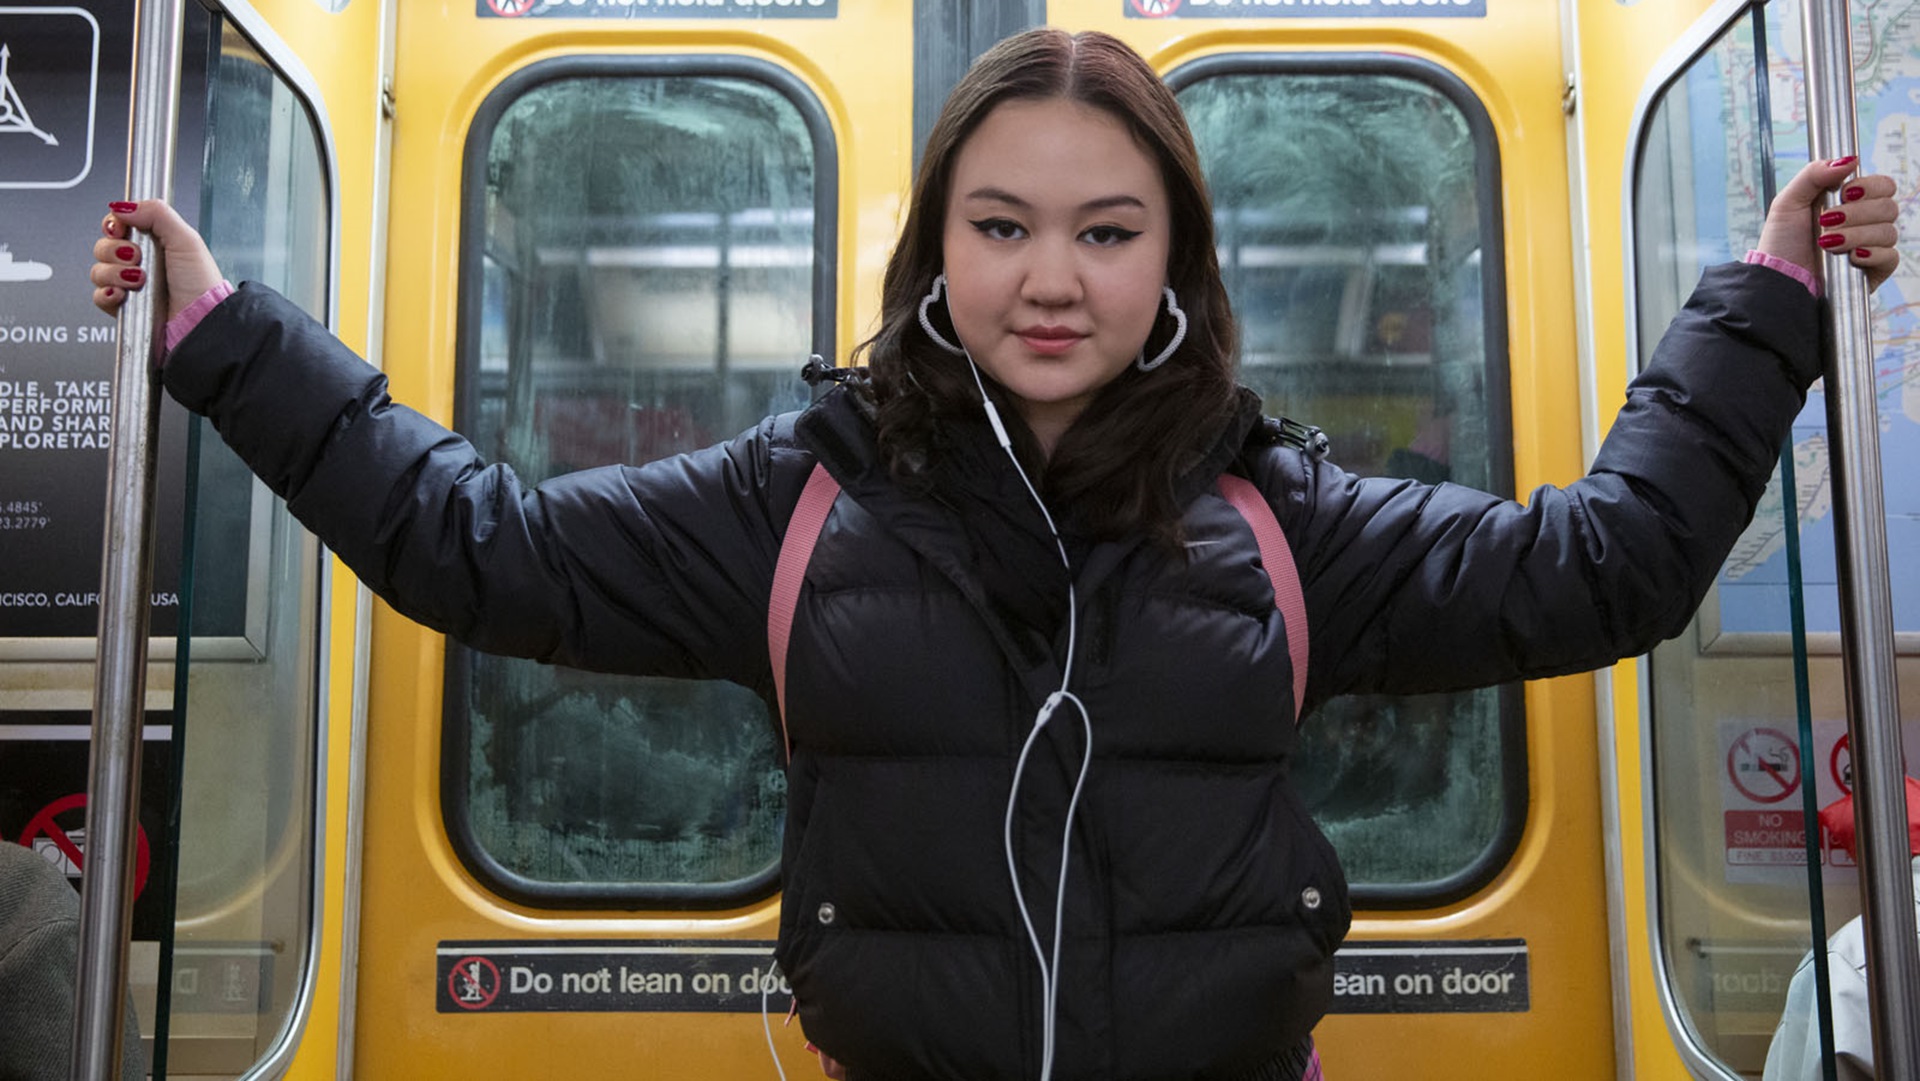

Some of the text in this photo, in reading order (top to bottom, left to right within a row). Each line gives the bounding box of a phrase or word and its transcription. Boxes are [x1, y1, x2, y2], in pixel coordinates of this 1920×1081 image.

[77, 326, 116, 343] SMI
[55, 381, 111, 397] TAKE
[0, 398, 111, 414] PERFORMI
[0, 415, 110, 431] AND SHAR
[0, 593, 51, 607] CISCO,
[151, 593, 179, 606] USA
[1759, 814, 1782, 827] NO
[510, 966, 552, 994] Do
[562, 968, 612, 994] not
[620, 966, 683, 994] lean
[692, 971, 731, 994] on
[1394, 973, 1433, 995] on
[1442, 967, 1515, 995] door
